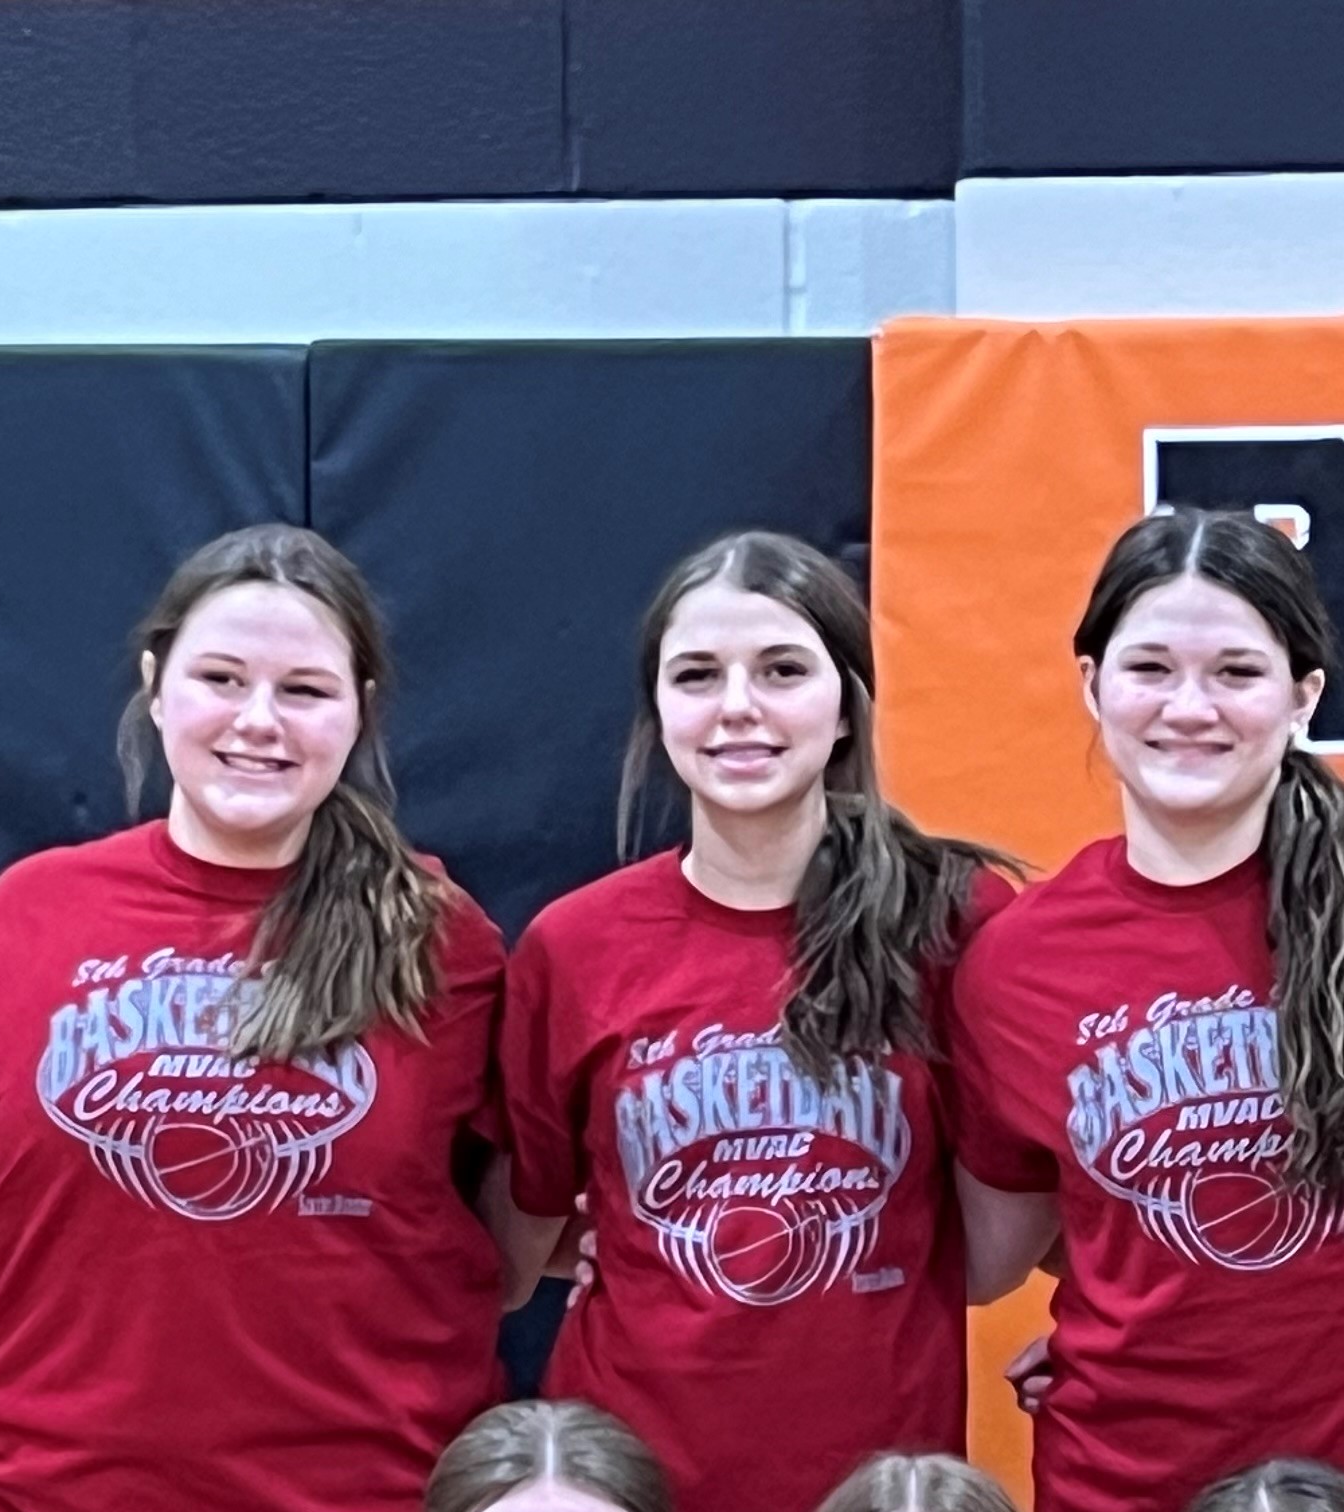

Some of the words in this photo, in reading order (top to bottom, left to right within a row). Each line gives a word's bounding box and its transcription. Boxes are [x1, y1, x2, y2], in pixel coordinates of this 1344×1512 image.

[142, 948, 248, 981] Grade
[1147, 984, 1255, 1031] Grade
[692, 1024, 785, 1060] Grad
[148, 1054, 261, 1078] MVAC
[74, 1069, 345, 1126] Champions
[1067, 1008, 1282, 1164] BASKETB
[1176, 1094, 1287, 1131] MVAC
[713, 1132, 815, 1163] MVAC
[1110, 1125, 1294, 1180] Champ
